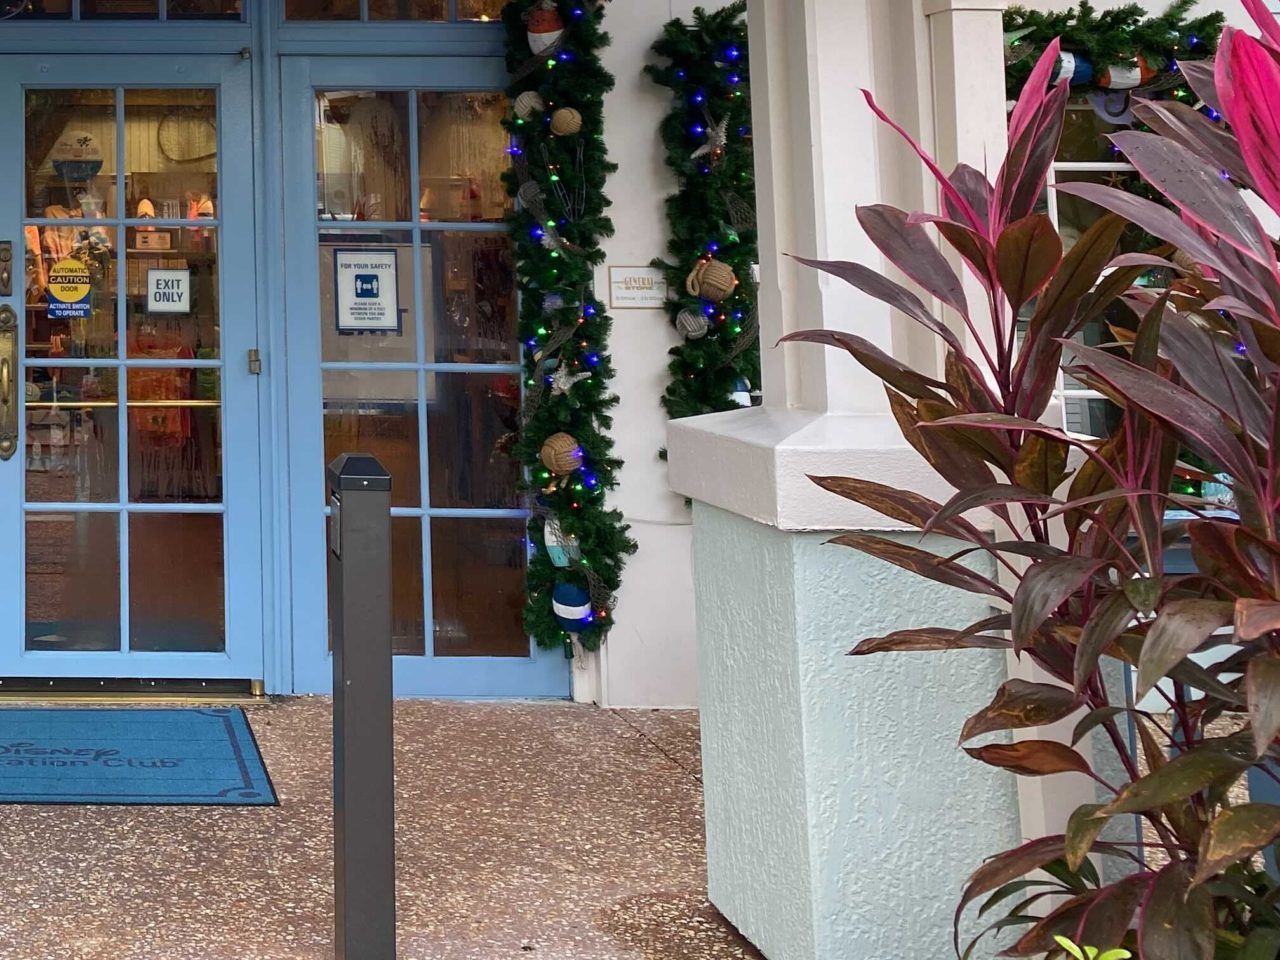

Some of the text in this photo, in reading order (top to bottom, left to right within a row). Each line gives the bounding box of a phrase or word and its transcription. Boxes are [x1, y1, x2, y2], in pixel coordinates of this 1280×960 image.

[156, 279, 182, 290] EXIT
[154, 291, 183, 303] ONLY
[103, 758, 181, 768] Club
